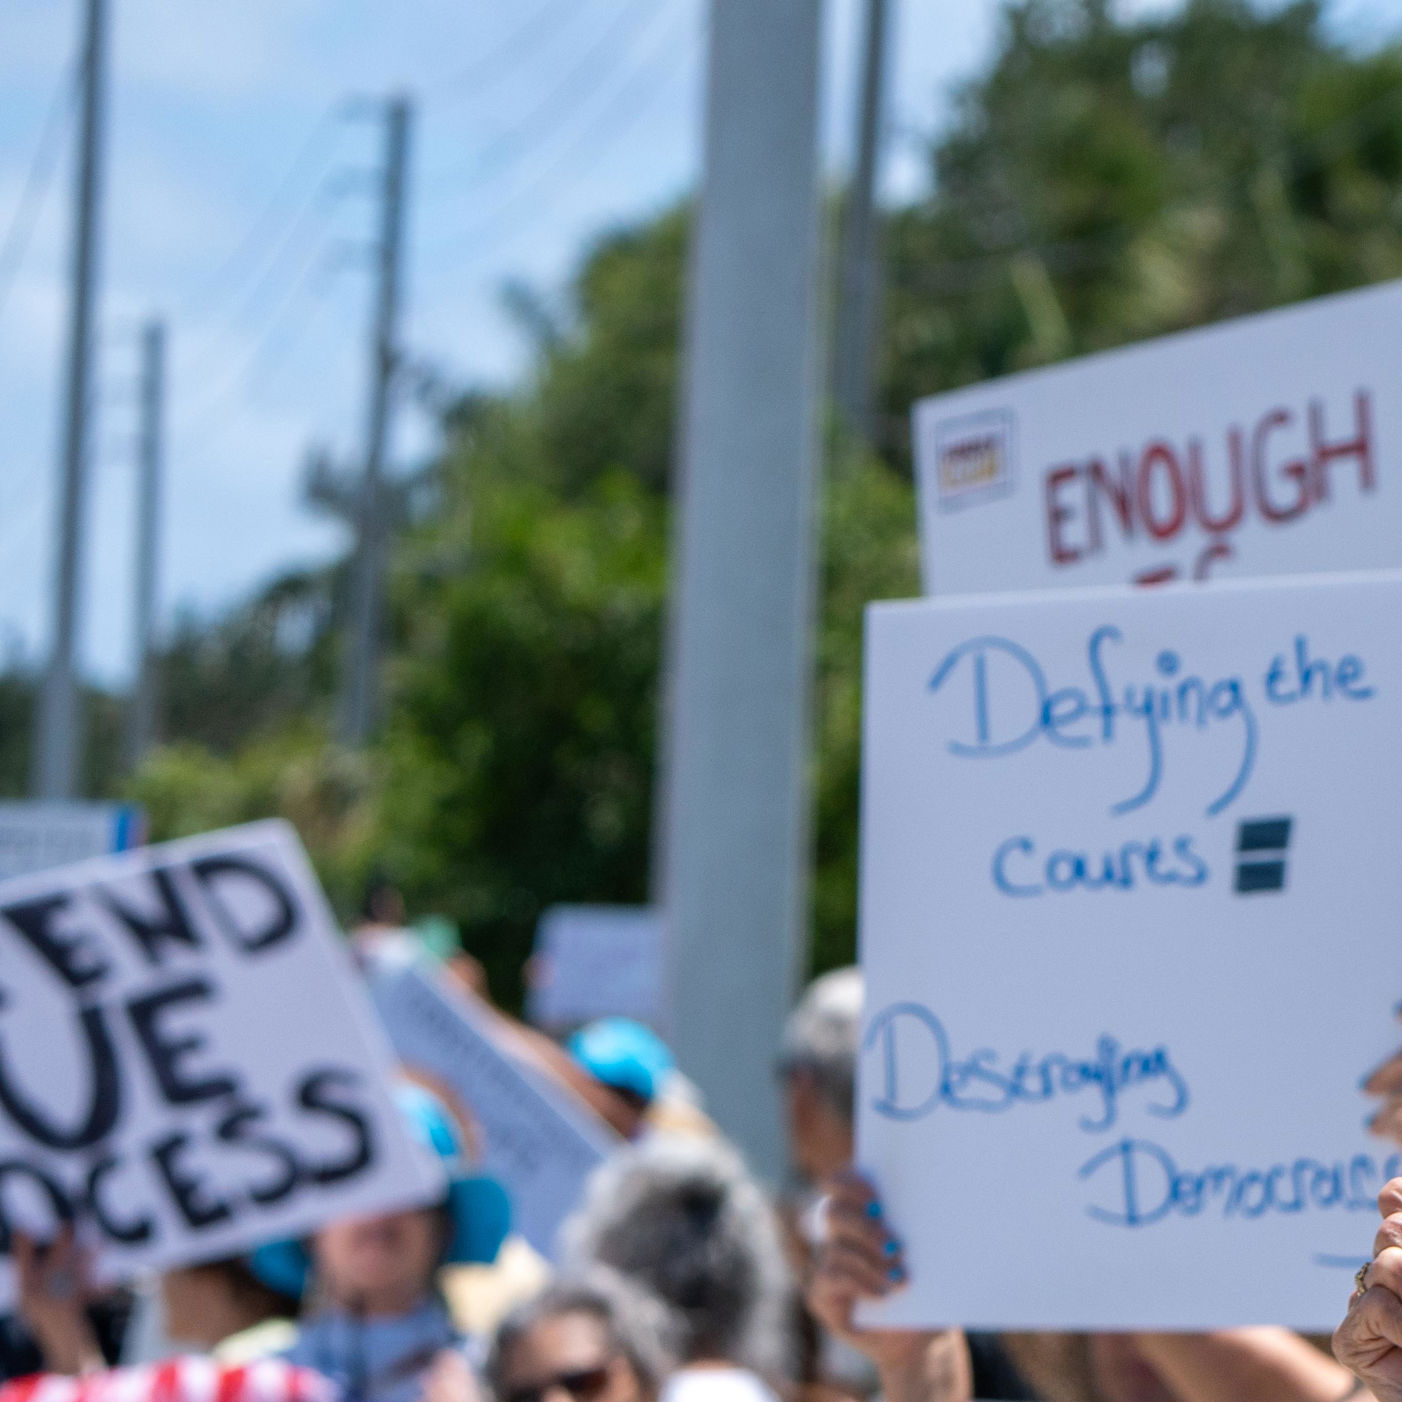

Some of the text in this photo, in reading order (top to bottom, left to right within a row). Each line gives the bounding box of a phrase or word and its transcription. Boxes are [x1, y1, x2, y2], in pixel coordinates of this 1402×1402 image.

[1041, 389, 1377, 568] ENOUGH
[927, 625, 1376, 818] Defying the
